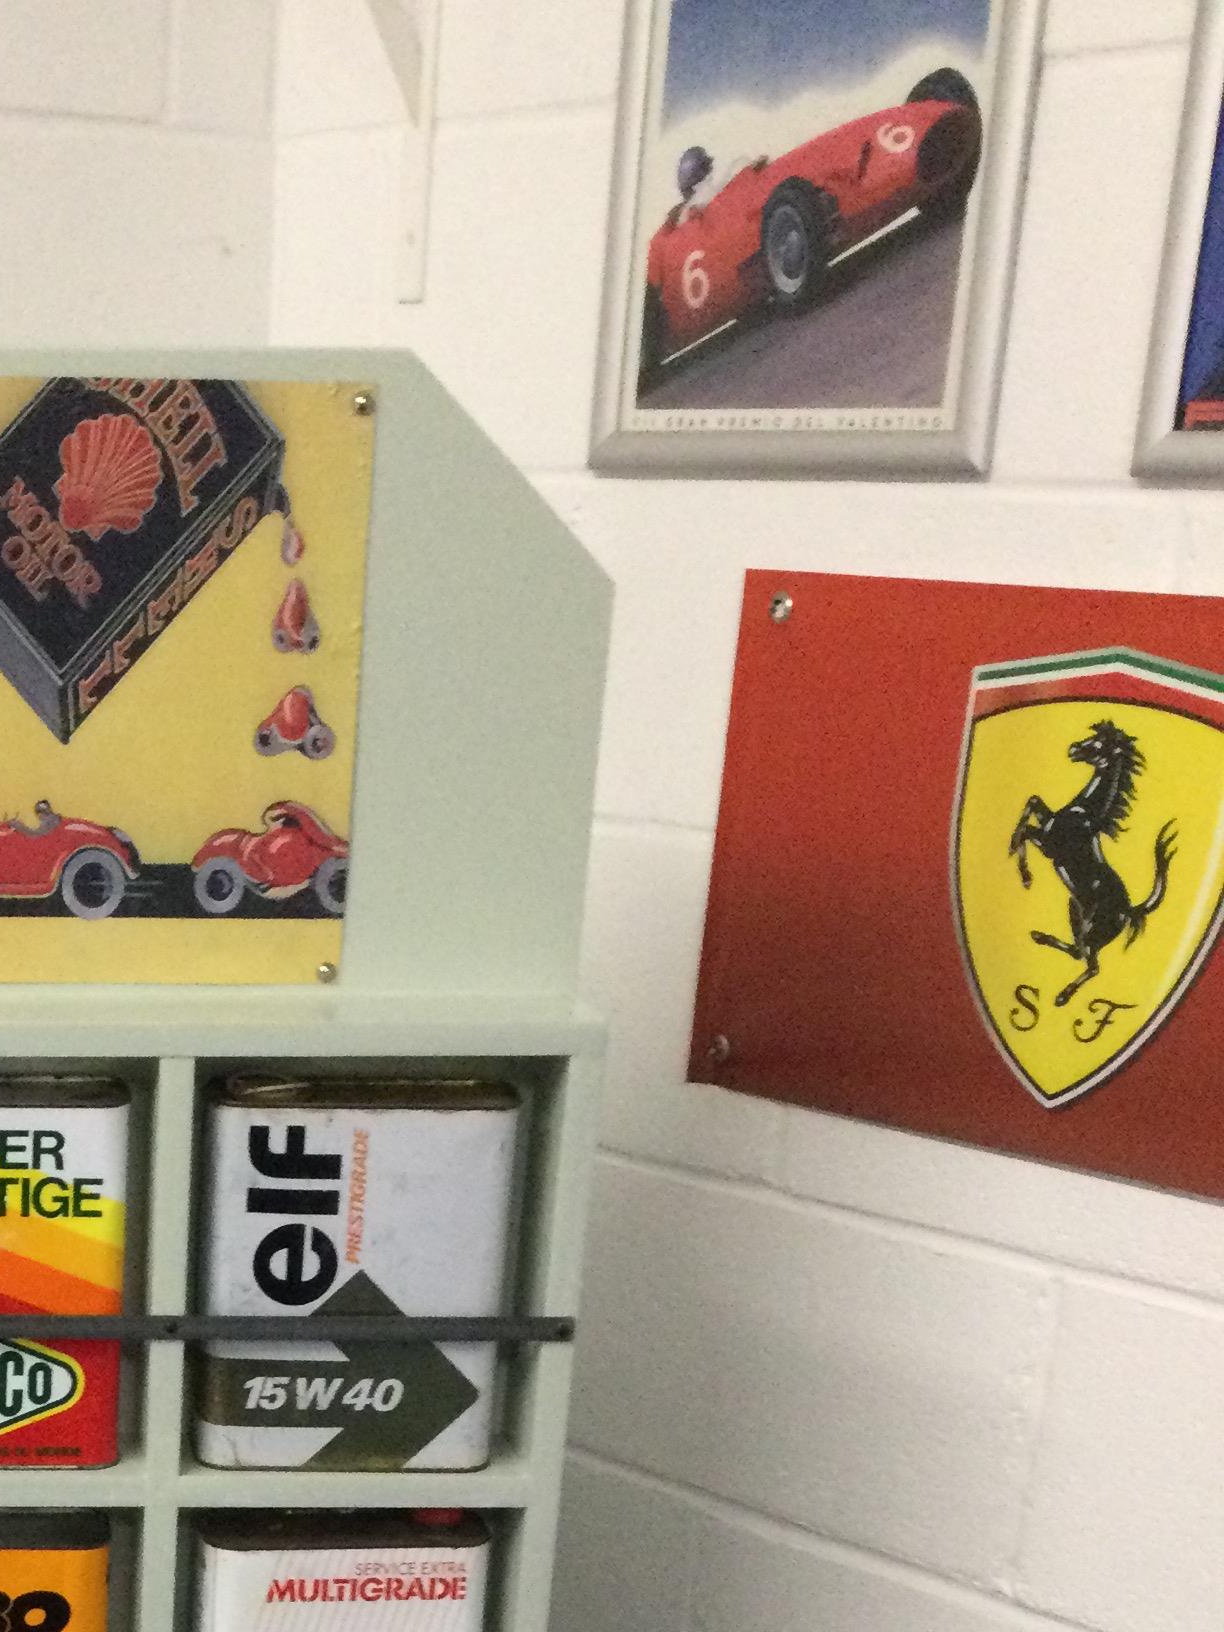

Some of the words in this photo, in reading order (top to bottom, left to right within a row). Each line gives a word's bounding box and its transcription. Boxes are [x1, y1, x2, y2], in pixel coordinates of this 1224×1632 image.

[877, 122, 916, 154] 6
[682, 250, 711, 309] 6
[1008, 983, 1041, 1032] S
[1073, 997, 1137, 1044] F
[245, 1125, 343, 1307] elf
[265, 1576, 468, 1602] MULTIGRADE
[354, 1561, 416, 1576] SERVICE
[421, 1561, 468, 1576] EXTRA
